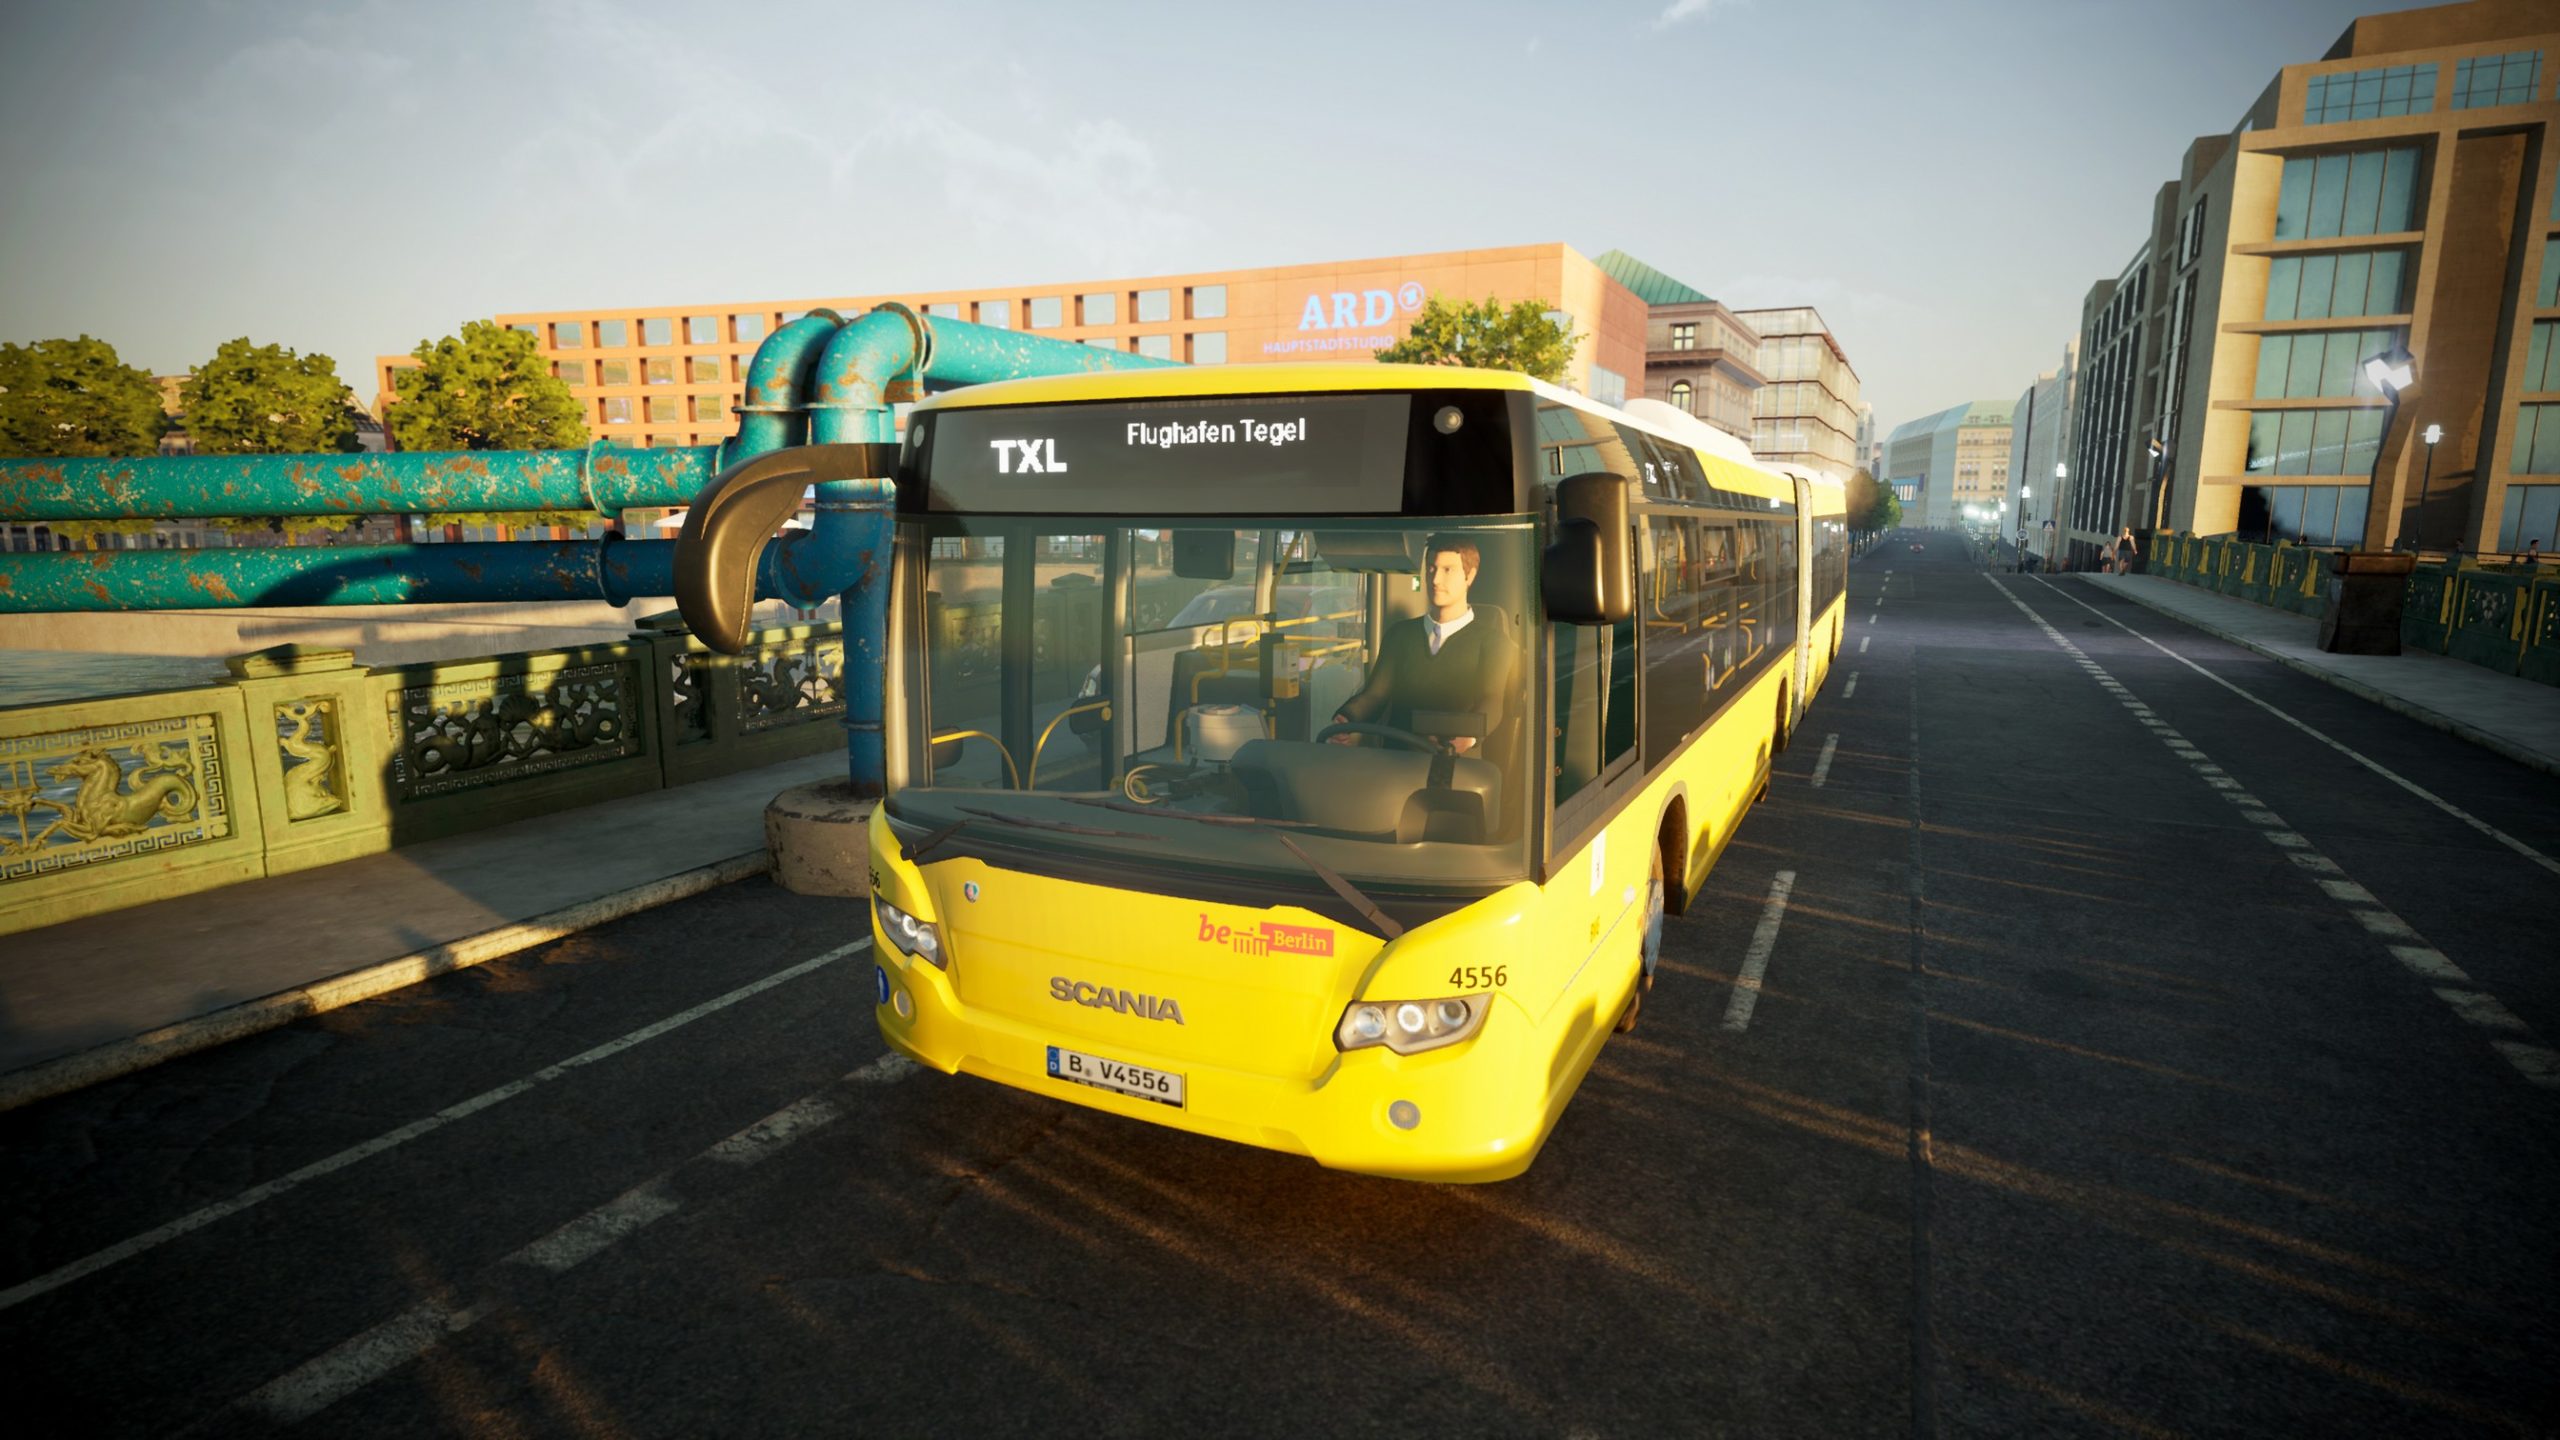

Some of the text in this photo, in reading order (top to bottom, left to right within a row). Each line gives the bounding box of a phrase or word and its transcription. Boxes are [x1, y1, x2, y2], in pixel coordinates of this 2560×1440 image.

[1299, 290, 1395, 330] ARD
[1264, 336, 1395, 353] HAUPTSTADTSTUDIO
[1127, 417, 1306, 448] Flughafen Tegel
[990, 439, 1067, 474] TXL
[1198, 913, 1327, 951] be Berlin
[1449, 965, 1508, 990] 4556
[1050, 976, 1184, 1025] SCANIA
[1100, 1061, 1170, 1093] V4556
